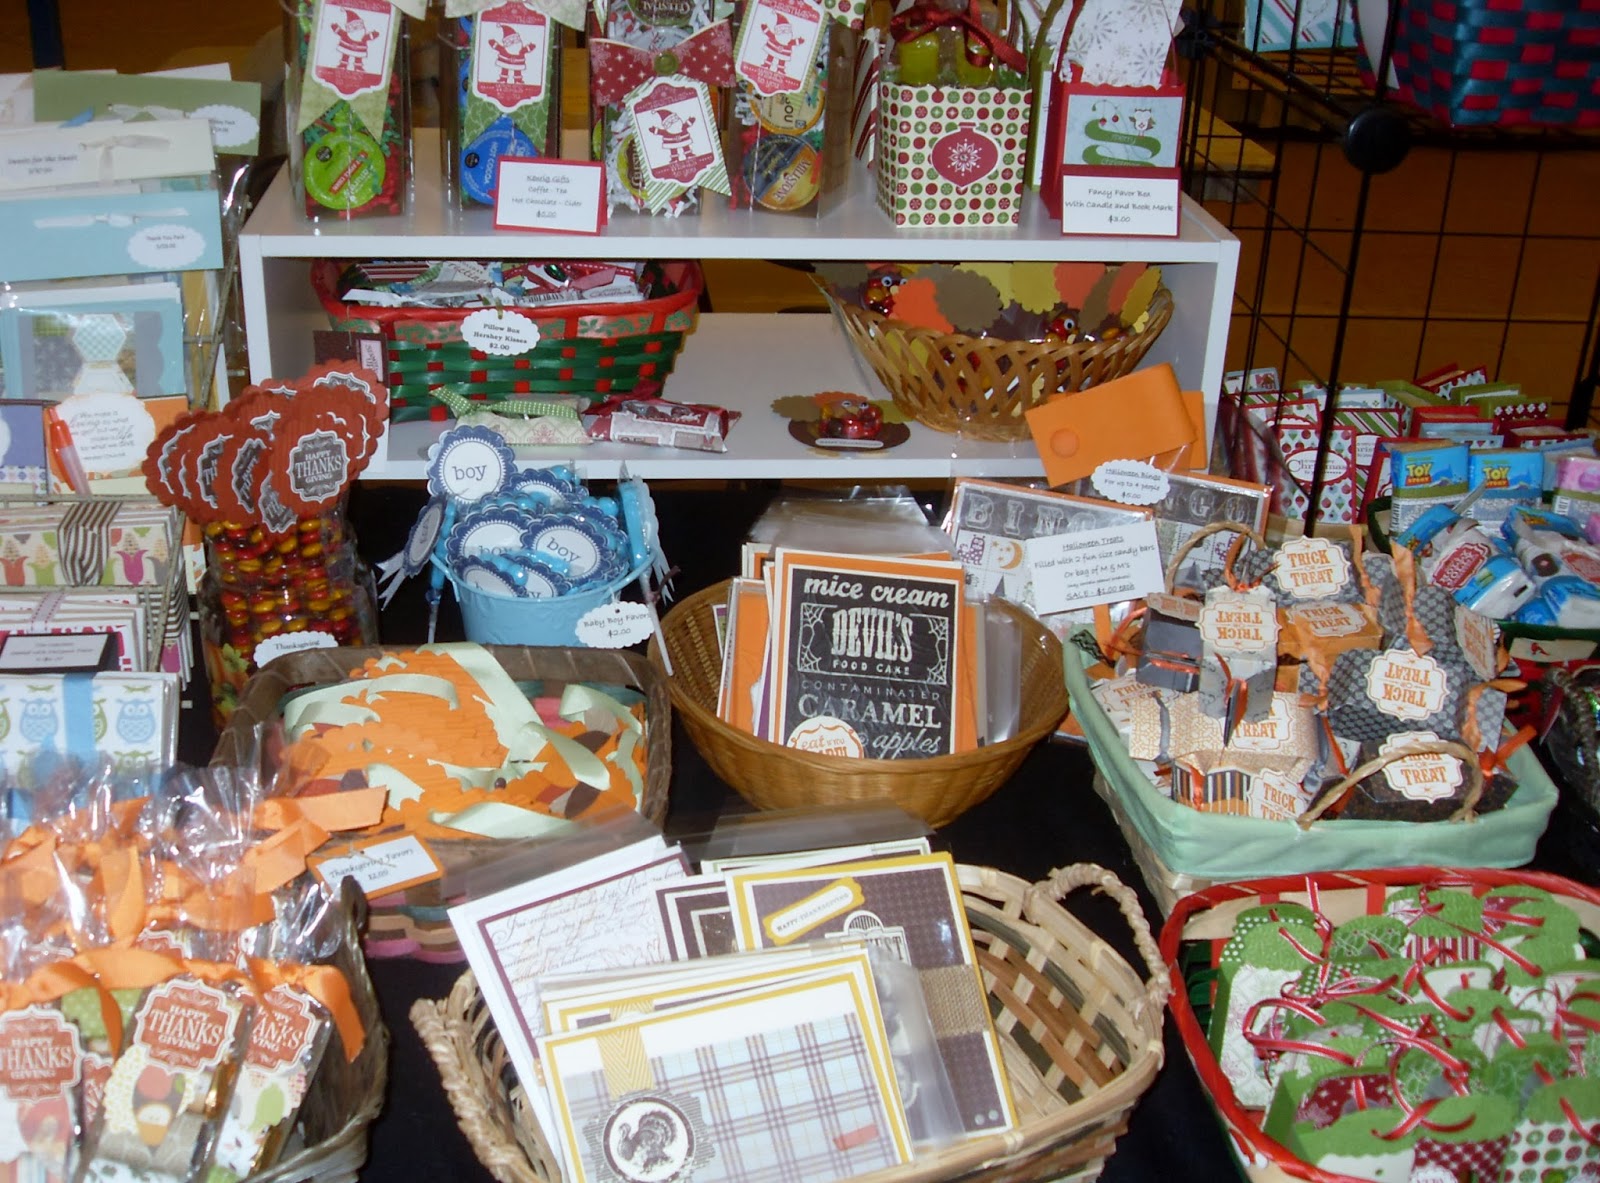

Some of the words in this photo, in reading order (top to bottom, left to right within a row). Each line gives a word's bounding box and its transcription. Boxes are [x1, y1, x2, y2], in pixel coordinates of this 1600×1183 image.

[773, 158, 812, 202] MILLSTONE
[1088, 188, 1113, 199] Fancy
[1115, 189, 1135, 197] Favor
[1115, 202, 1129, 210] and
[1132, 203, 1150, 211] Book
[483, 323, 505, 332] Pillow
[474, 331, 503, 341] Hershey
[505, 335, 528, 344] Kisses
[489, 342, 510, 351] $2.00
[305, 450, 331, 461] HAPPY
[295, 454, 342, 479] THANKS
[452, 464, 488, 481] boy
[1105, 468, 1139, 477] Halloween
[1406, 462, 1433, 477] TOY
[1483, 466, 1511, 480] TOY
[305, 472, 332, 483] GIVING
[547, 537, 580, 563] boy
[1063, 540, 1100, 551] Halloween
[1102, 536, 1124, 546] Treats
[1034, 560, 1055, 569] Filled
[1057, 557, 1073, 565] with
[1082, 553, 1096, 563] fun
[1099, 551, 1113, 559] size
[1115, 547, 1138, 557] candy
[1140, 544, 1155, 552] bars
[1287, 549, 1331, 566] TRICK
[1075, 569, 1089, 577] bag
[1091, 565, 1100, 575] of
[1117, 562, 1130, 570] M's
[1290, 569, 1334, 587] TREAT
[804, 575, 864, 600] mice
[870, 584, 950, 608] cream
[1066, 591, 1089, 601] SALE
[1096, 586, 1117, 597] $1.00
[1119, 583, 1135, 591] each
[1215, 610, 1263, 625] TREAT
[1300, 606, 1345, 619] TRICK
[583, 619, 605, 628] Baby
[607, 617, 623, 625] Boy
[1306, 614, 1353, 630] TREAT
[608, 628, 631, 638] $2.00
[831, 607, 914, 663] DEVIL'S
[1216, 626, 1263, 641] TRICK
[274, 639, 321, 652] Thanksgiving
[833, 659, 868, 671] FOOD
[876, 664, 910, 676] CAKE
[1384, 662, 1432, 687] TREAT
[802, 680, 940, 700] CONTAMINATED
[1382, 683, 1427, 708] TRICK
[798, 693, 942, 729] CARAMEL
[1234, 722, 1278, 739] TREAT
[801, 735, 826, 750] eat
[872, 728, 941, 760] apples
[1400, 765, 1448, 787] TREAT
[1263, 782, 1297, 814] TRICK
[329, 857, 385, 879] Thanksgiving
[385, 848, 414, 862] Favors
[169, 1005, 210, 1023] HAPPY
[149, 1008, 224, 1047] THANKS
[11, 1037, 53, 1048] HAPPY
[158, 1033, 201, 1052] GIVING
[11, 1069, 56, 1080] GIVING
